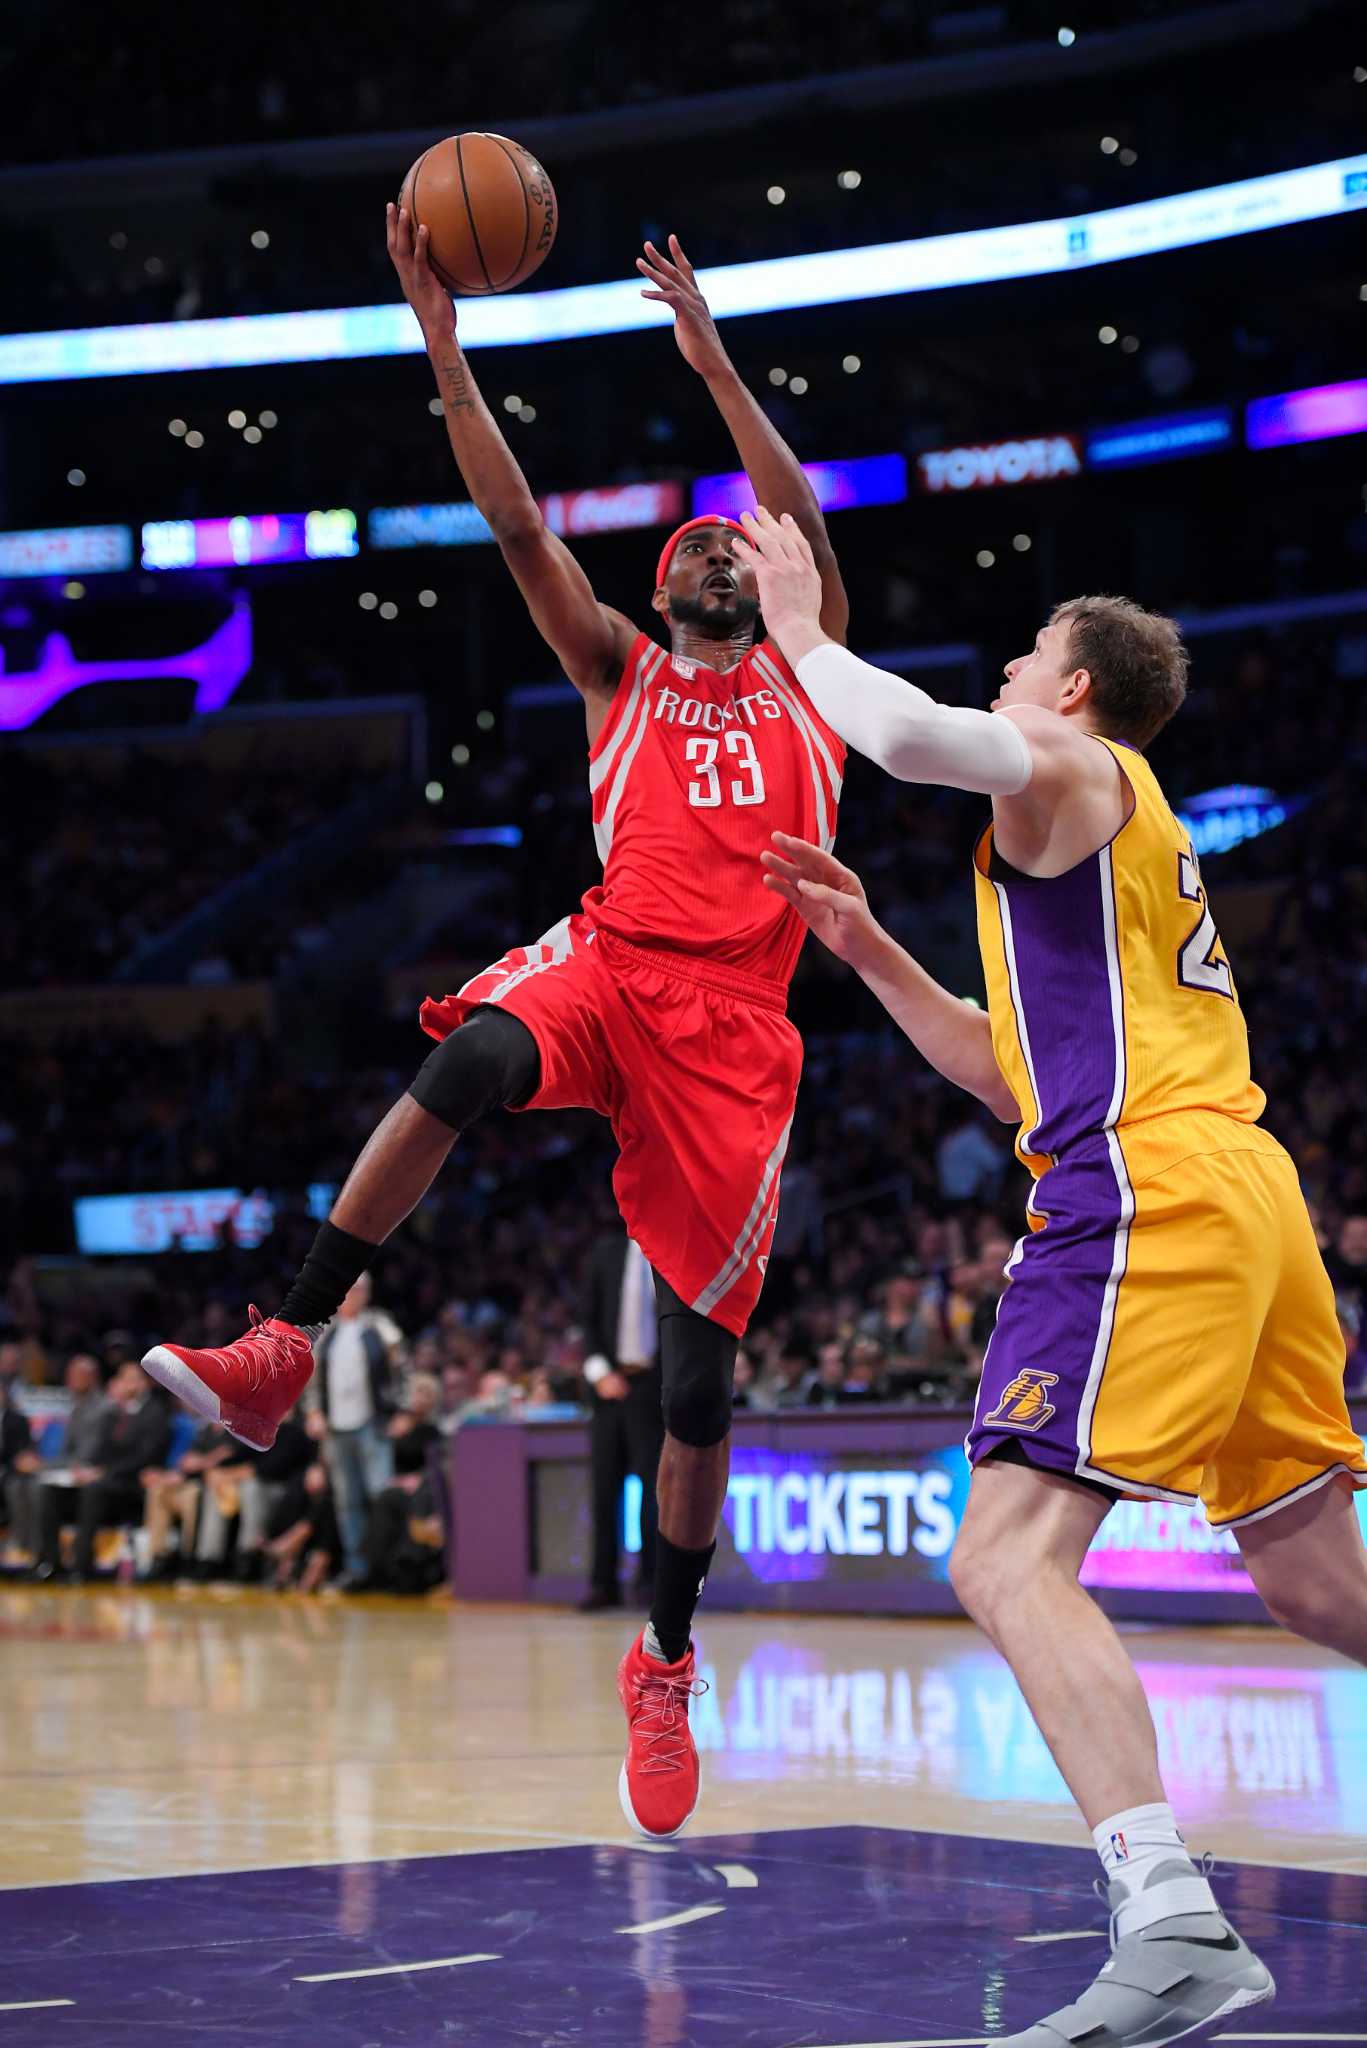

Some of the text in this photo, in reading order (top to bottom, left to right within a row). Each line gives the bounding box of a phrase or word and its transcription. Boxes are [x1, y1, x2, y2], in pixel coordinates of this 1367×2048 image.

[917, 436, 1080, 492] TOYOTA
[654, 686, 781, 732] ROCKTS
[686, 730, 766, 807] 33
[727, 1470, 957, 1558] TICKETS
